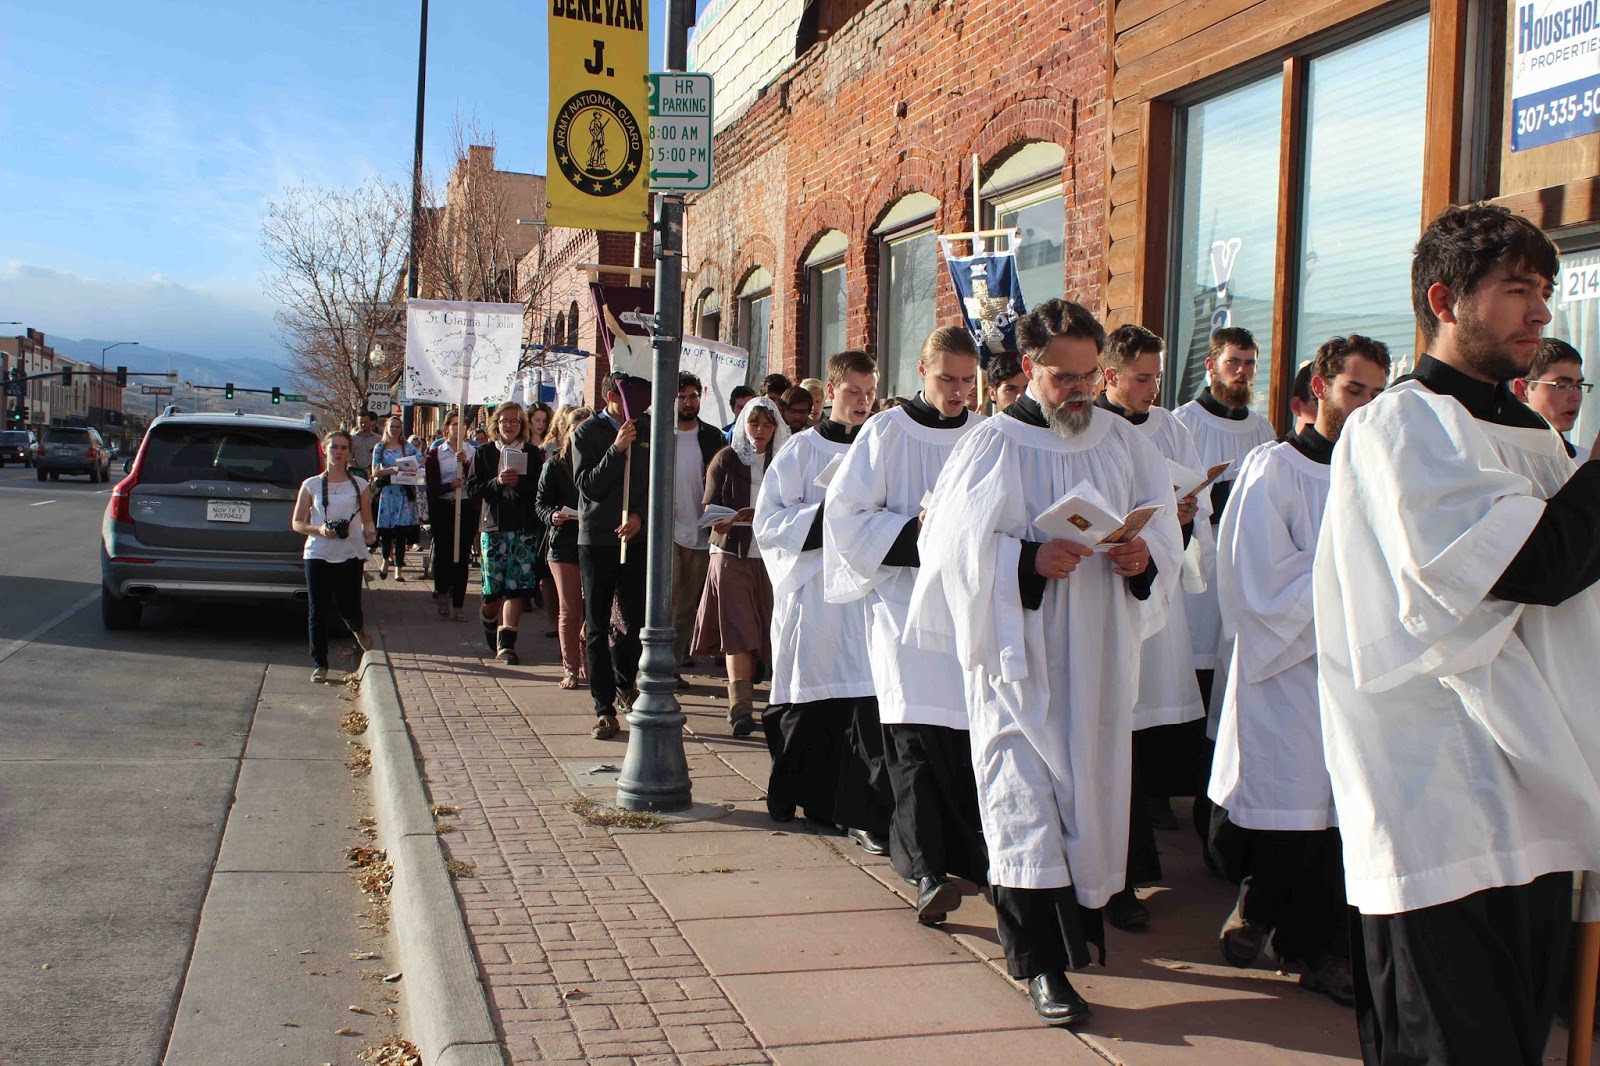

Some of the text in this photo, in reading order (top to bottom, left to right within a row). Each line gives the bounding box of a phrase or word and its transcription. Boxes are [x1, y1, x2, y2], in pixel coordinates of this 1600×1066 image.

[1518, 0, 1600, 54] HOUSEHOL
[584, 39, 614, 77] J.
[675, 79, 694, 94] HR
[662, 97, 706, 113] PARKING
[1517, 87, 1600, 135] 307-335-50
[557, 110, 571, 148] ARMY
[569, 93, 616, 114] NATIONAL
[618, 108, 640, 151] GUARD
[649, 125, 698, 140] 8:00 AM
[658, 147, 686, 162] 5:00
[690, 147, 706, 162] PM
[1568, 269, 1600, 297] 214
[693, 348, 705, 358] OF
[370, 400, 388, 410] 287
